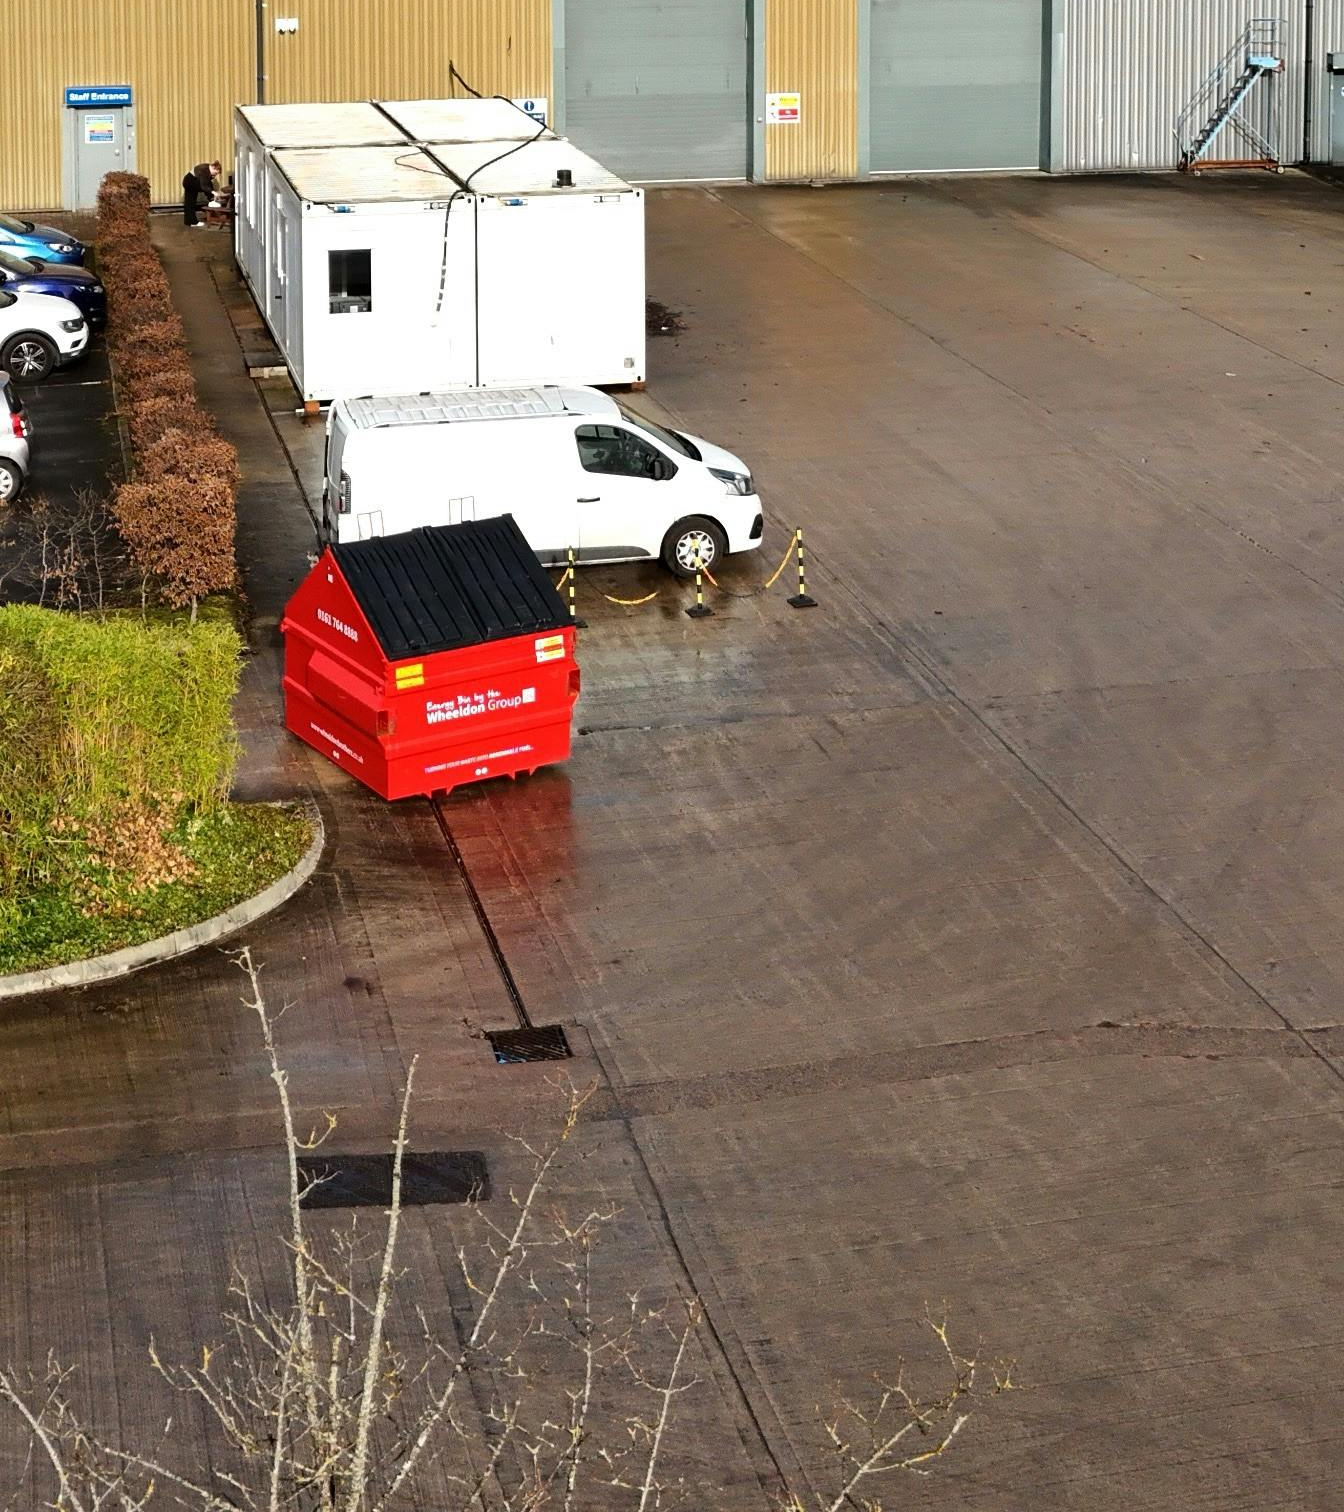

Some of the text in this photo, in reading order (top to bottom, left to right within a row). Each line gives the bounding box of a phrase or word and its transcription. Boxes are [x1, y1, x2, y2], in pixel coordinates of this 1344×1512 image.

[317, 608, 332, 626] 0161
[332, 617, 343, 632] 764
[426, 701, 454, 711] Energy
[457, 695, 471, 704] Bin
[474, 693, 484, 703] by
[426, 696, 522, 724] Wheeldon Group
